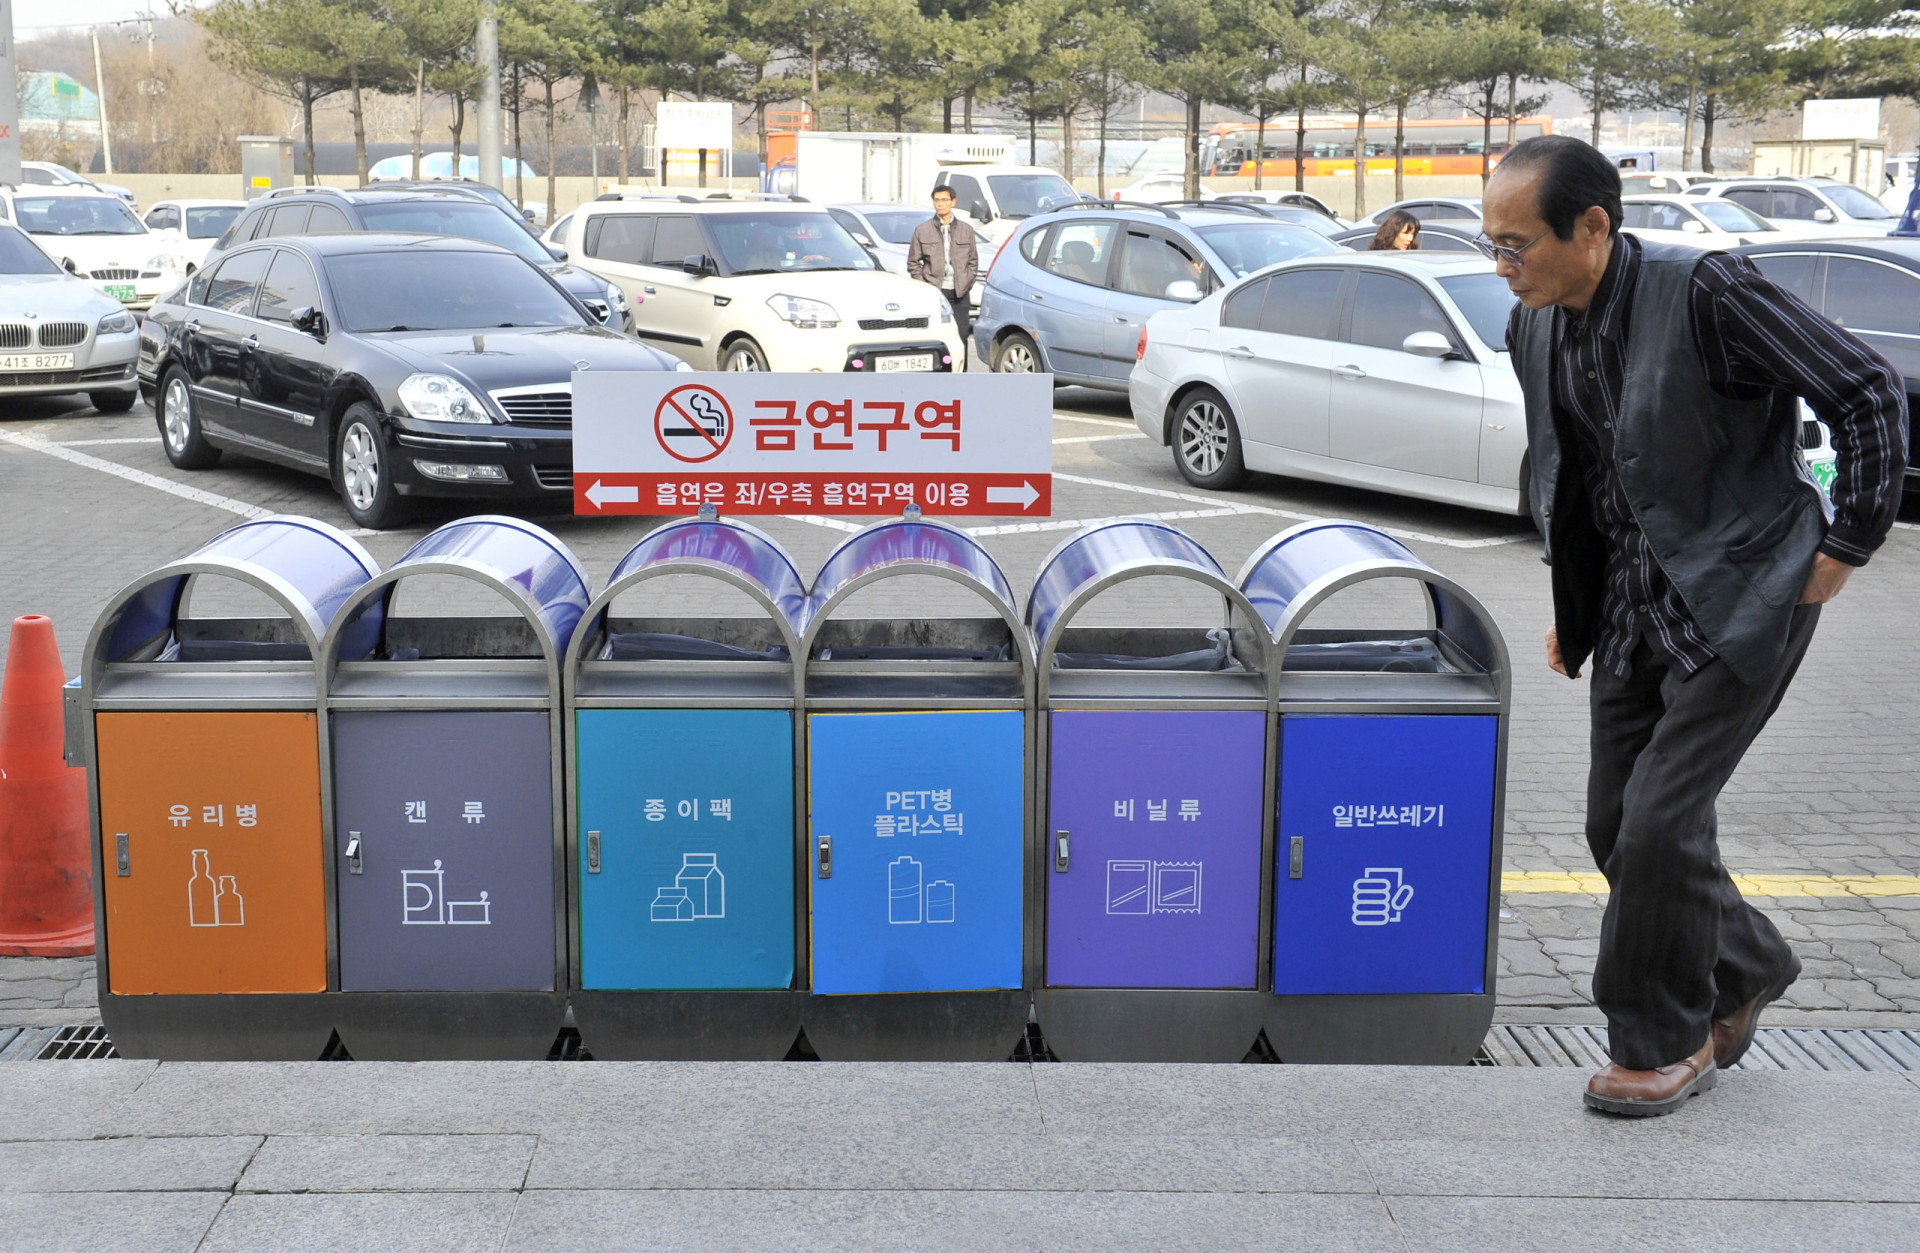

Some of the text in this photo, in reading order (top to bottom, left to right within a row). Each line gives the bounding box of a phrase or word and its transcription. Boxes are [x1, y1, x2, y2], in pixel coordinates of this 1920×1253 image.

[35, 354, 67, 367] 8277
[905, 357, 928, 369] 1842
[750, 399, 961, 452] 금연구역
[656, 482, 970, 507] 흡연은 좌/우측 흡연구역 이용
[886, 788, 952, 812] PET병
[873, 813, 963, 837] 플라스틱
[1332, 804, 1445, 829] 일반쓰레기
